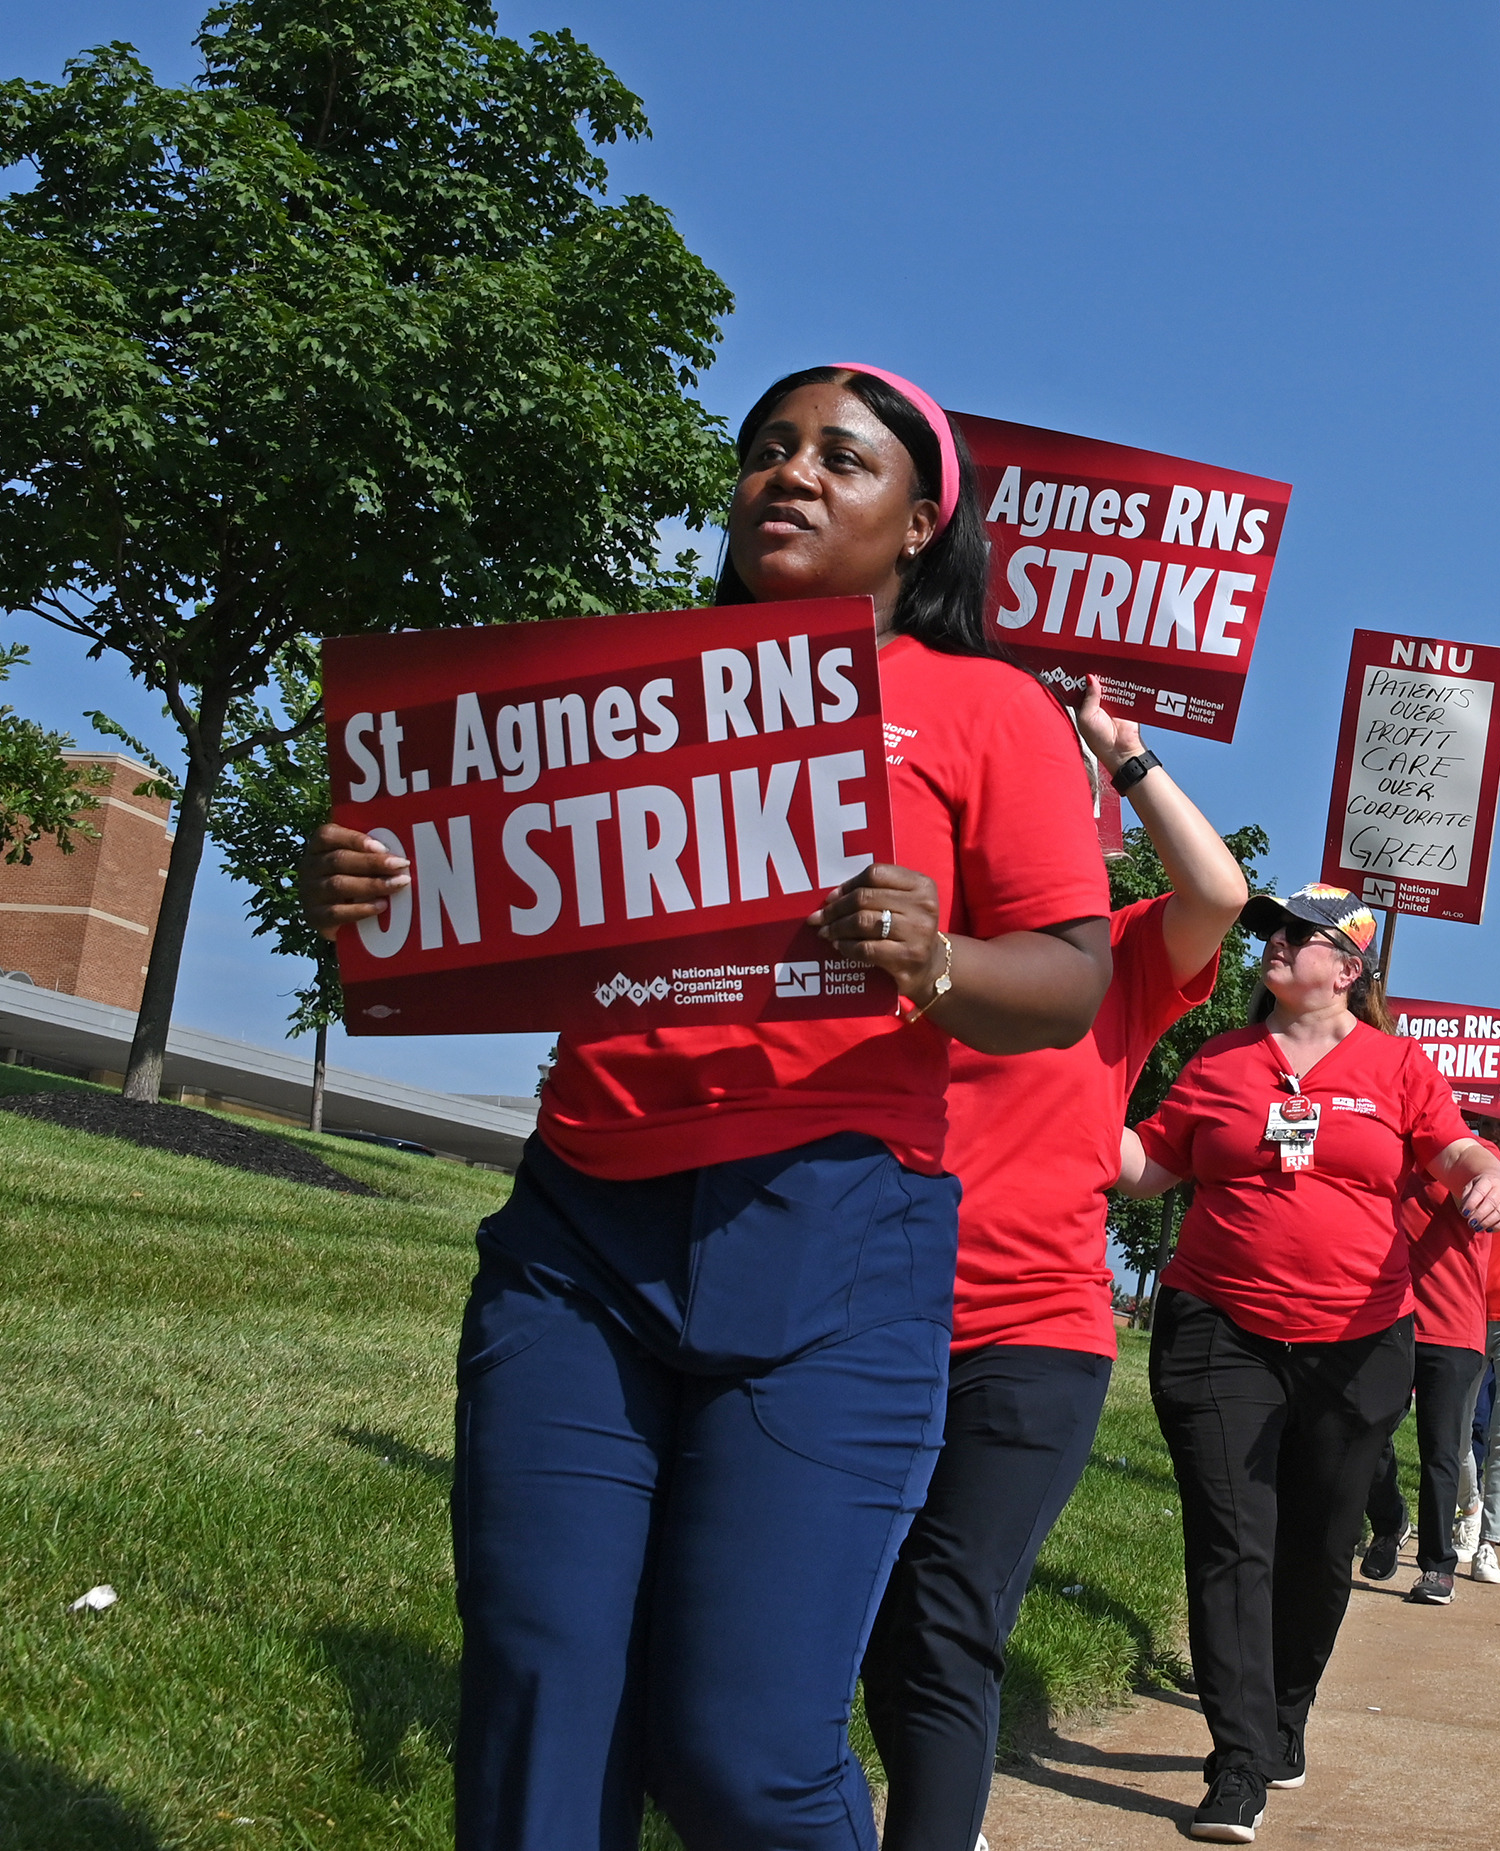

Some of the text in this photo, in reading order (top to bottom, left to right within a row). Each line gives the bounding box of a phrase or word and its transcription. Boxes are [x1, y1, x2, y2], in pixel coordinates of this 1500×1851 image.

[986, 465, 1270, 555] Agnes RNs
[996, 545, 1256, 657] STRIKE
[1390, 639, 1474, 673] NNU
[1100, 685, 1136, 700] rganizing
[1128, 682, 1155, 695] Nurses
[1367, 670, 1474, 708] PATIENTS
[1188, 705, 1216, 717] Nurses
[1190, 697, 1224, 711] National
[345, 634, 859, 803] St. Agnes RNs
[1187, 713, 1213, 725] United
[1390, 701, 1445, 726] OVER
[1366, 720, 1457, 749] PROFIT
[1361, 747, 1465, 778] CARE
[1347, 795, 1473, 827] CORPORATE
[356, 750, 874, 959] ON STRIKE
[1349, 826, 1457, 871] GREED
[1399, 883, 1439, 896] National
[1398, 892, 1430, 904] Nurses
[1397, 901, 1429, 912] United
[1442, 910, 1464, 918] AFL-CIO
[672, 963, 769, 981] National Nurses
[825, 972, 866, 982] Nurses
[673, 979, 743, 994] Organizing
[825, 983, 865, 995] United
[674, 992, 744, 1005] Committee
[1396, 1013, 1459, 1040] Agnes
[1420, 1043, 1500, 1078] TRIKE
[1286, 1155, 1309, 1167] RN
